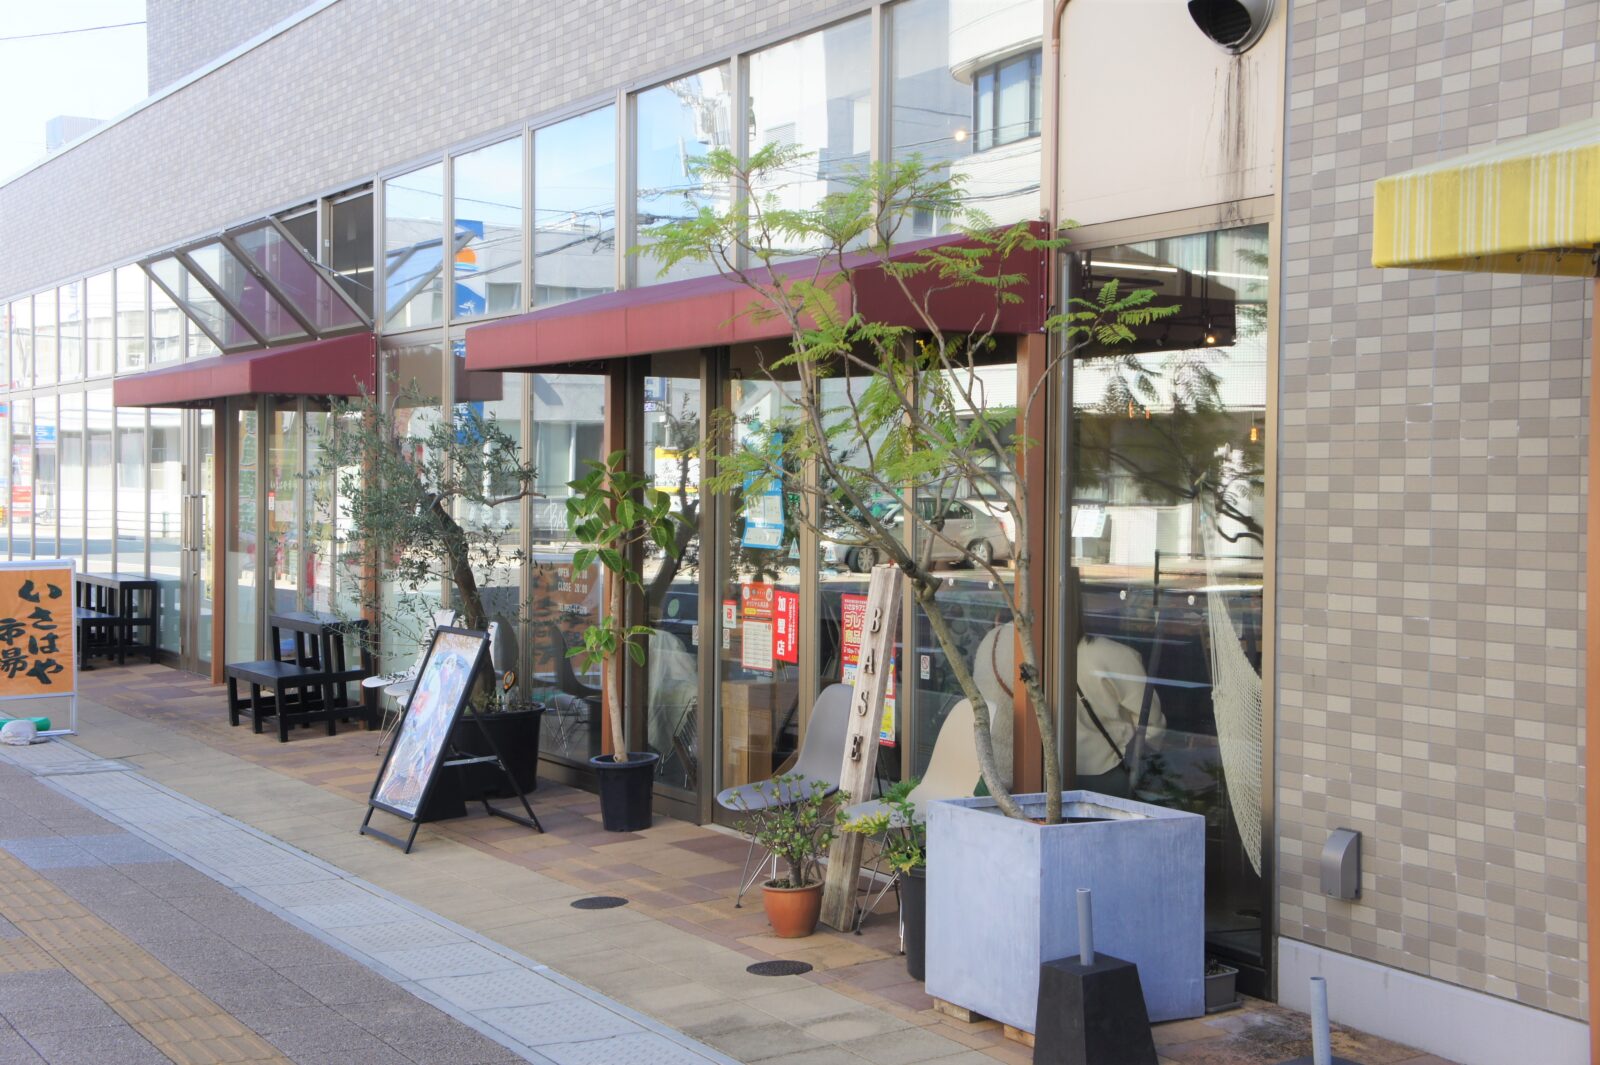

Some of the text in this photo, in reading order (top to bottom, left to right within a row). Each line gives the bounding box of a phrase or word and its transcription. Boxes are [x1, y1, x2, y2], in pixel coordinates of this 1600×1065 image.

[557, 567, 570, 577] OPEN
[557, 582, 571, 592] CLOSE
[0, 617, 28, 679] 市場
[18, 579, 64, 685] いさはや
[851, 607, 883, 762] BASE
